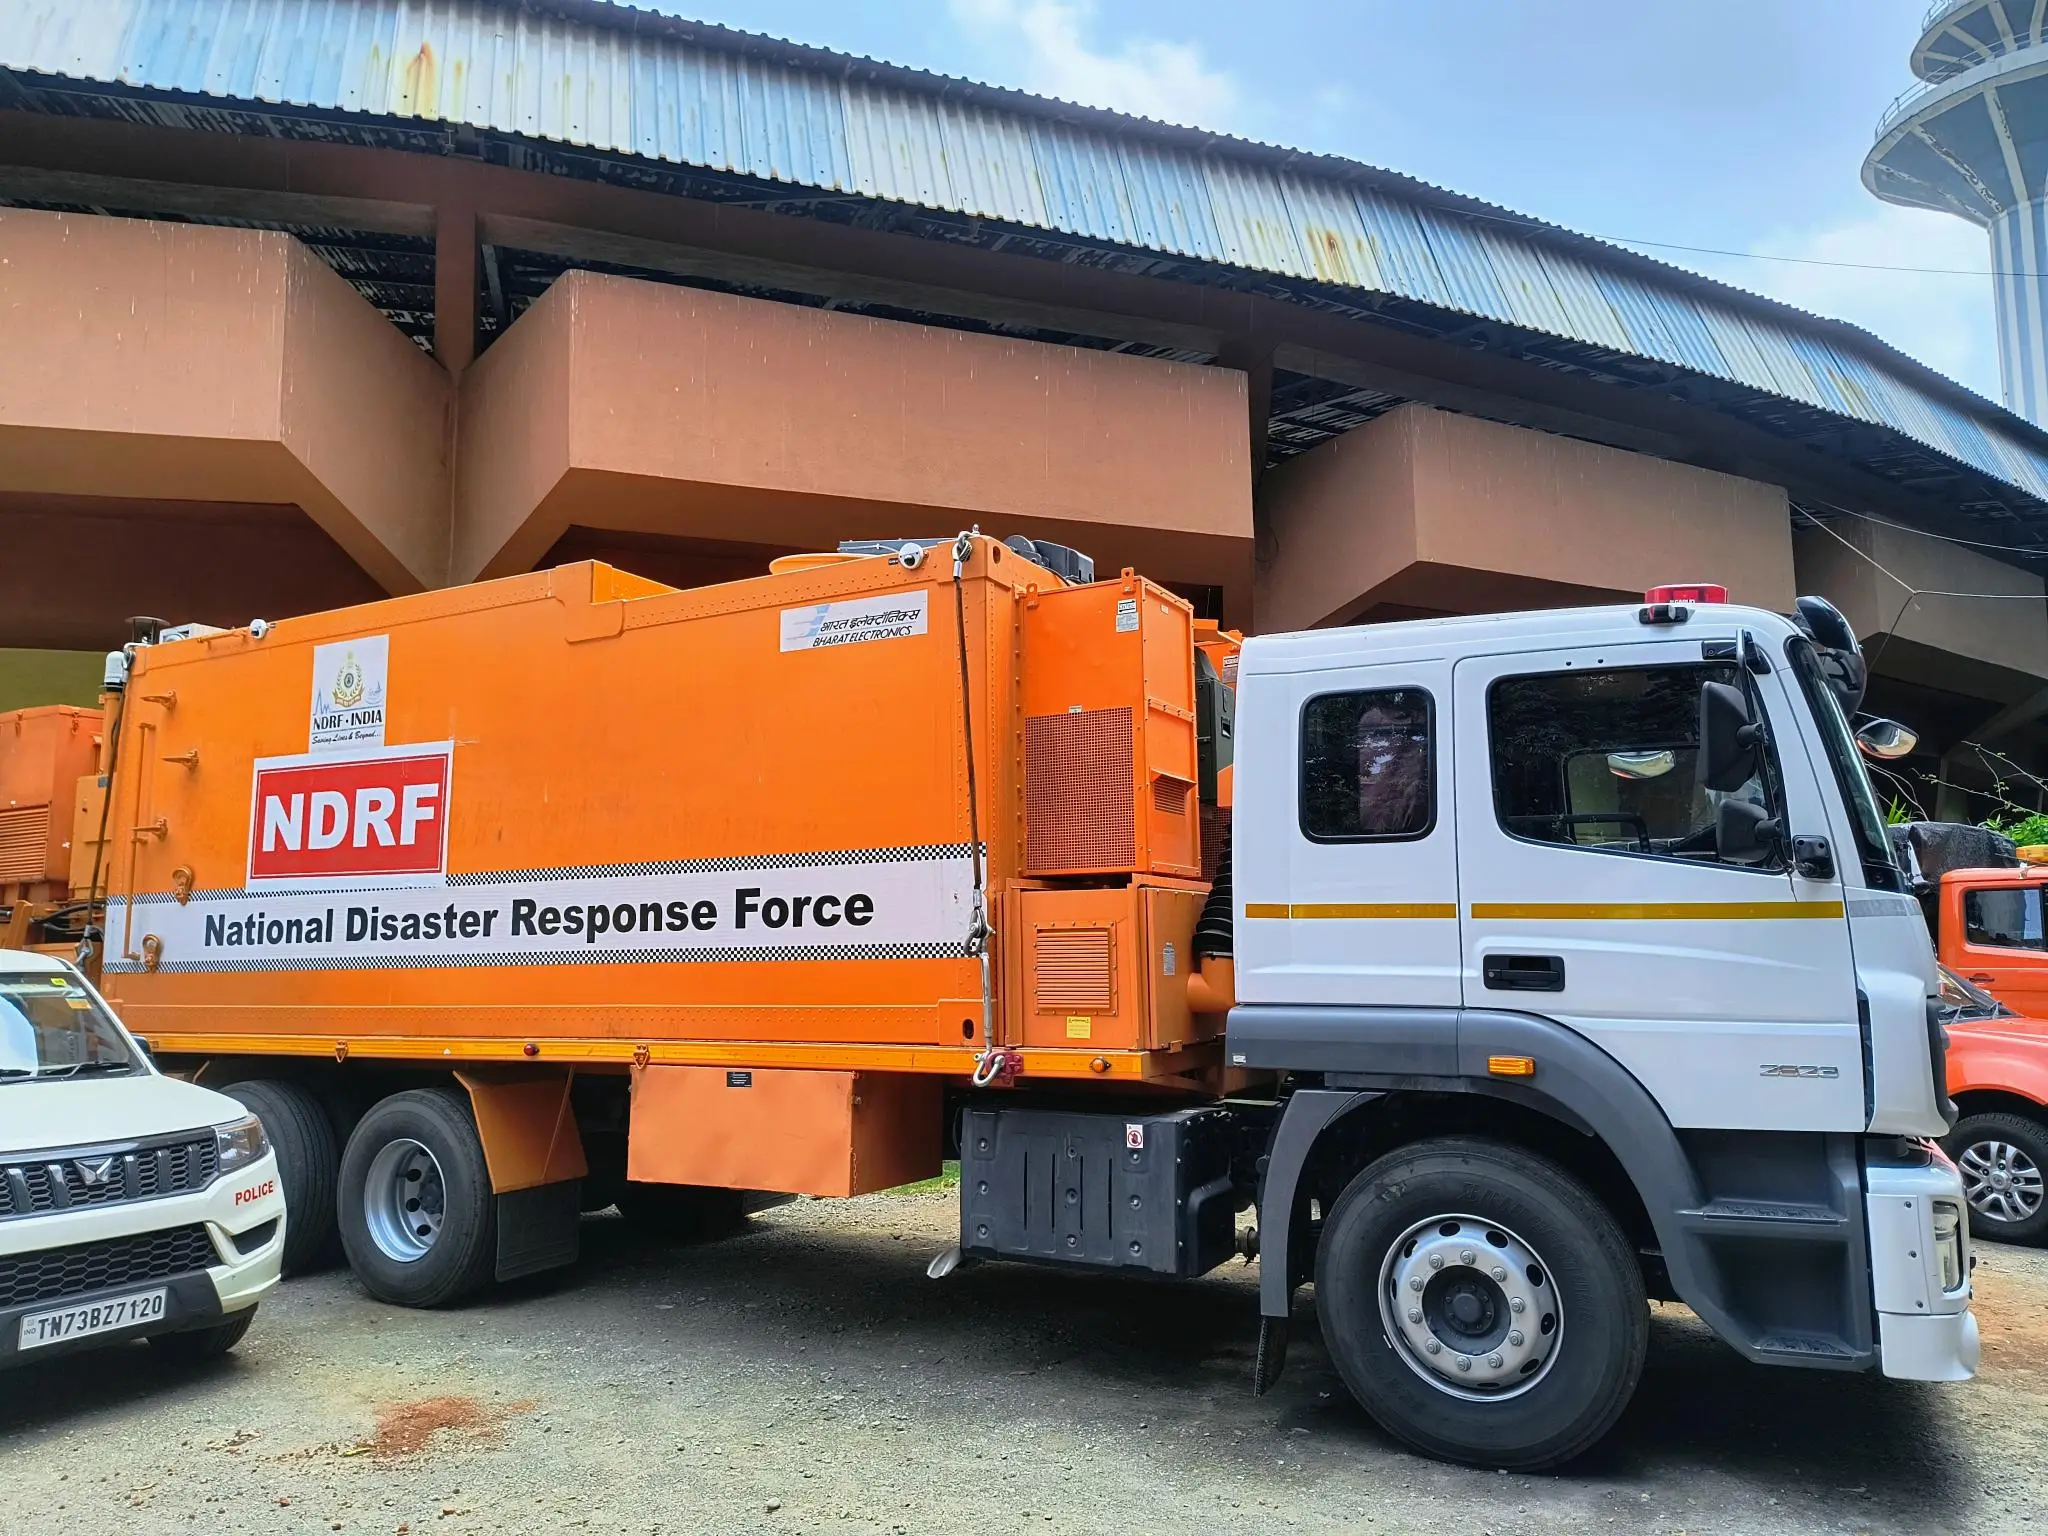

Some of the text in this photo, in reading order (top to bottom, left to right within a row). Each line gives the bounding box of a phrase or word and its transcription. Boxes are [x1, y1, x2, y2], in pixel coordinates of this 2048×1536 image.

[812, 625, 913, 647] BHARAT ELECTRONICS
[313, 709, 382, 730] NDRF INDIA
[262, 783, 439, 852] NDRF
[204, 887, 875, 947] National Disaster Response Force
[235, 1180, 274, 1206] POLICE
[38, 1295, 163, 1340] TN73BZ7120
